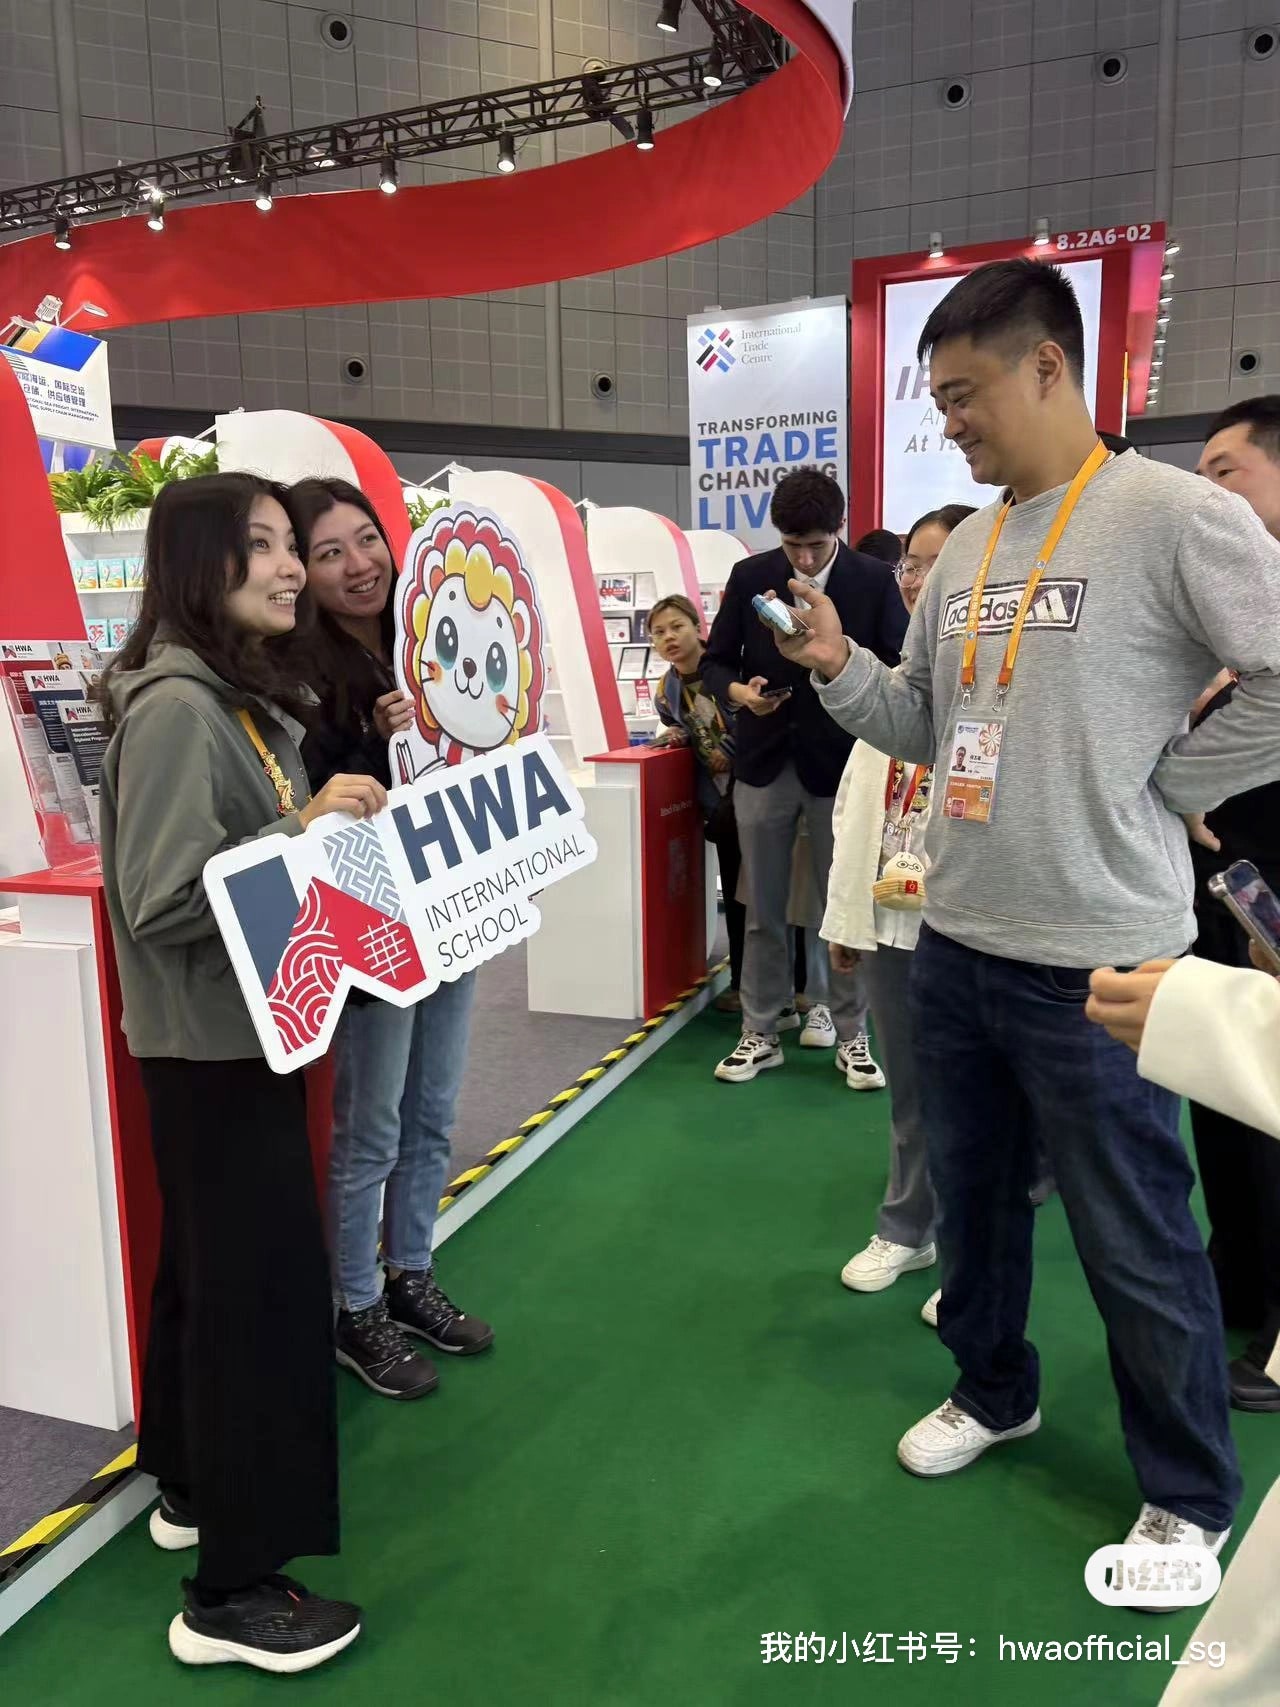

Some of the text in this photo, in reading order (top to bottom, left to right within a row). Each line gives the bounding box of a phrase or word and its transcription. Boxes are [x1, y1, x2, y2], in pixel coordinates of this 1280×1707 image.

[1056, 224, 1152, 250] 8.2A6-02
[741, 322, 802, 340] International
[741, 352, 773, 365] Centre
[742, 341, 769, 352] Trade
[697, 410, 838, 436] TRANSFORMING
[698, 427, 839, 469] TRADE
[904, 434, 929, 453] At
[698, 463, 838, 492] CHANGG
[699, 492, 772, 530] LIV
[948, 597, 1019, 628] addas
[76, 706, 92, 714] HWA
[391, 751, 573, 885] HWA
[424, 834, 586, 932] INTERNATIONAL
[437, 902, 529, 968] SCHOOL
